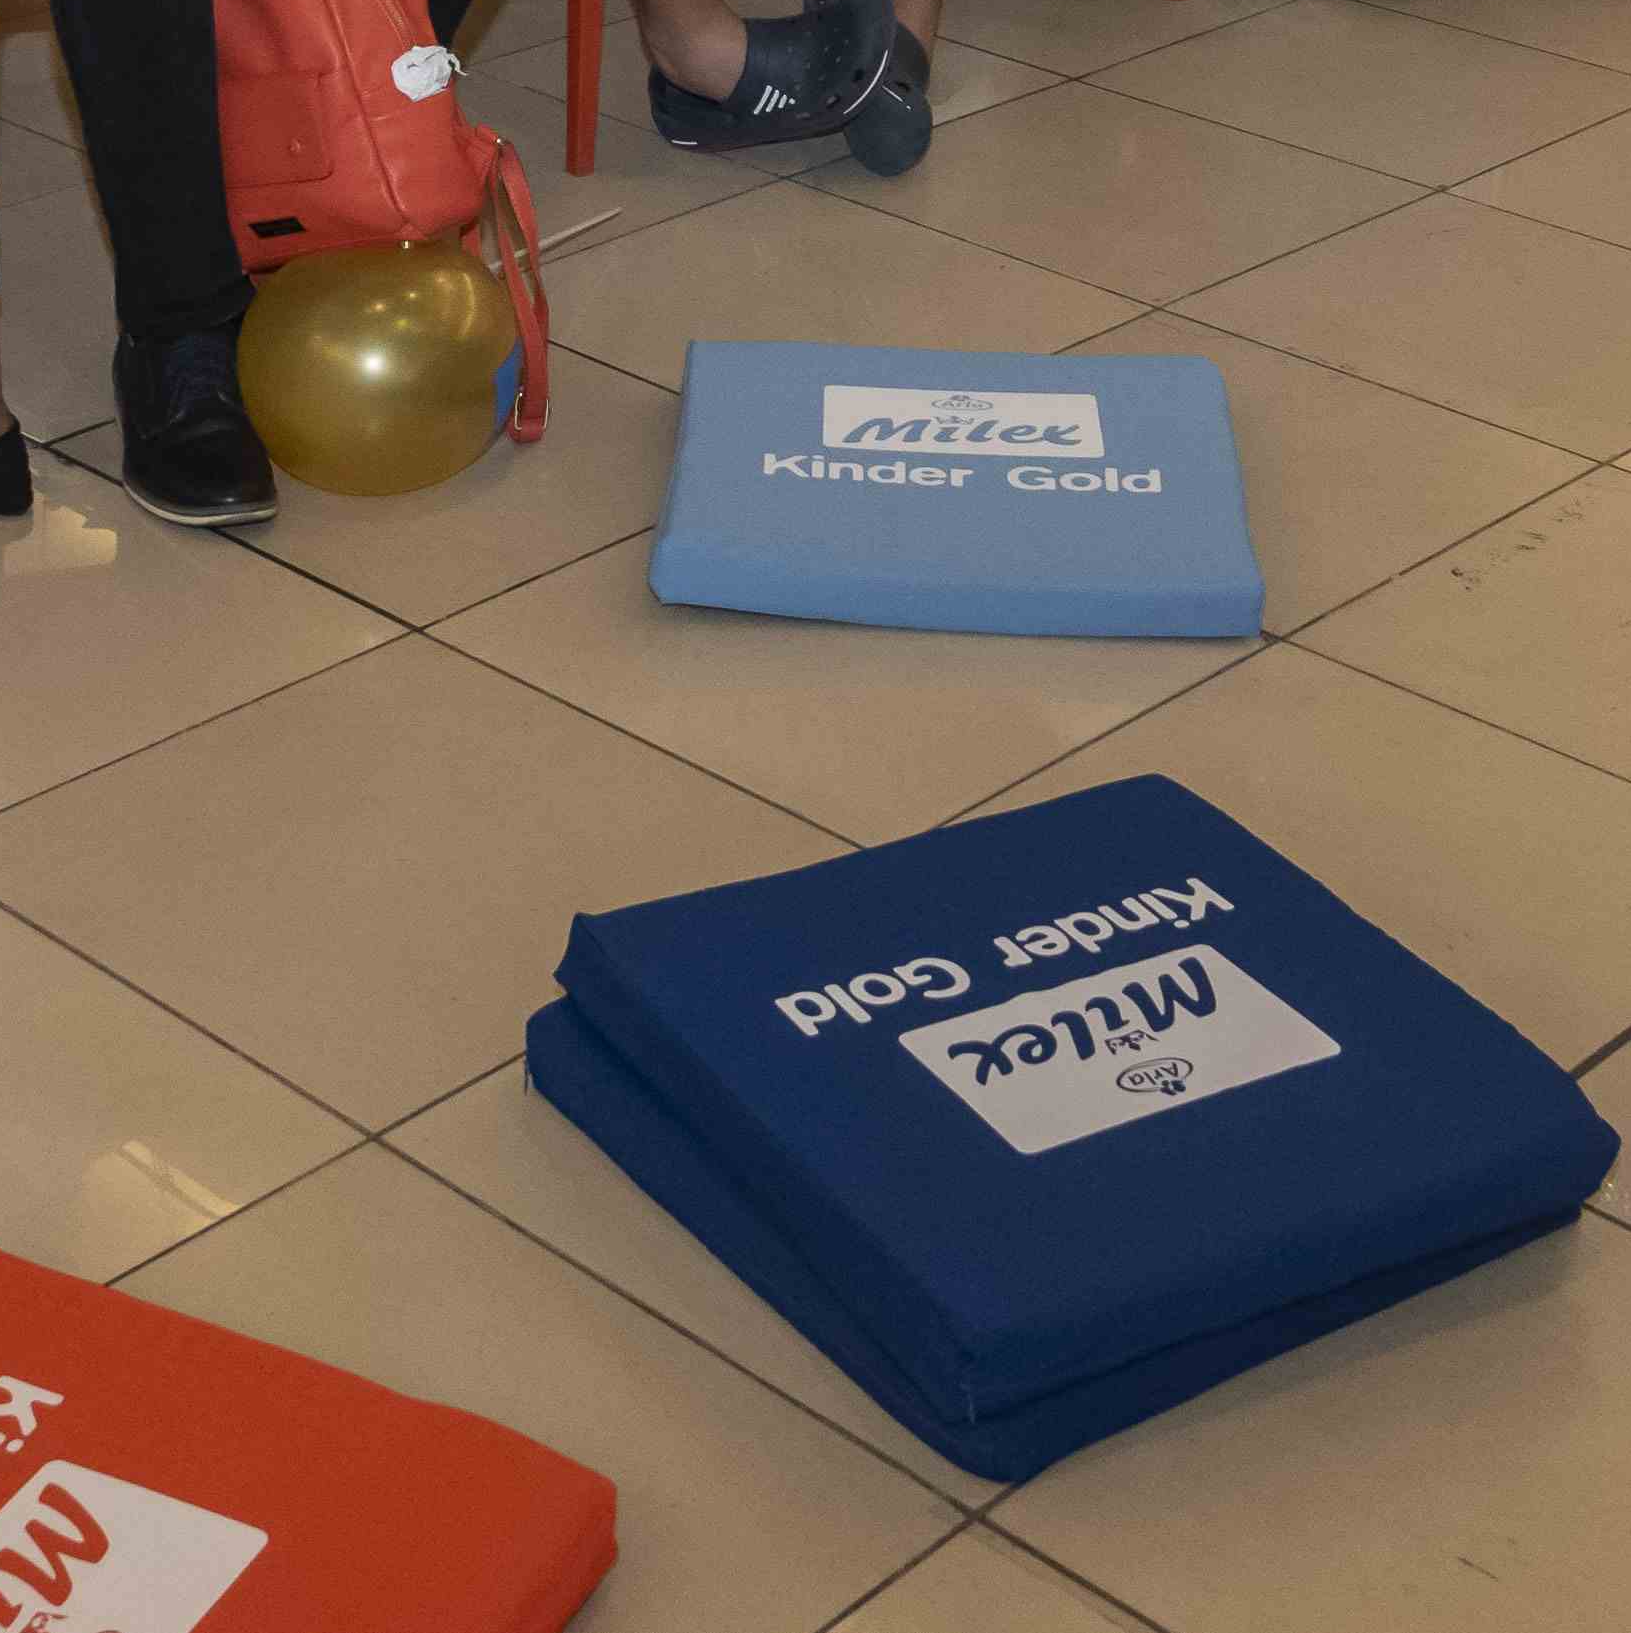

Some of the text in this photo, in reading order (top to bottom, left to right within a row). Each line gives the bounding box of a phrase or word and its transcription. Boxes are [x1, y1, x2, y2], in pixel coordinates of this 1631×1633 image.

[841, 415, 1083, 446] Milex
[762, 452, 1163, 494] Kinder Gold
[774, 877, 1235, 1037] Kinder Gold
[947, 956, 1219, 1086] Milex
[1127, 1060, 1182, 1089] Arla
